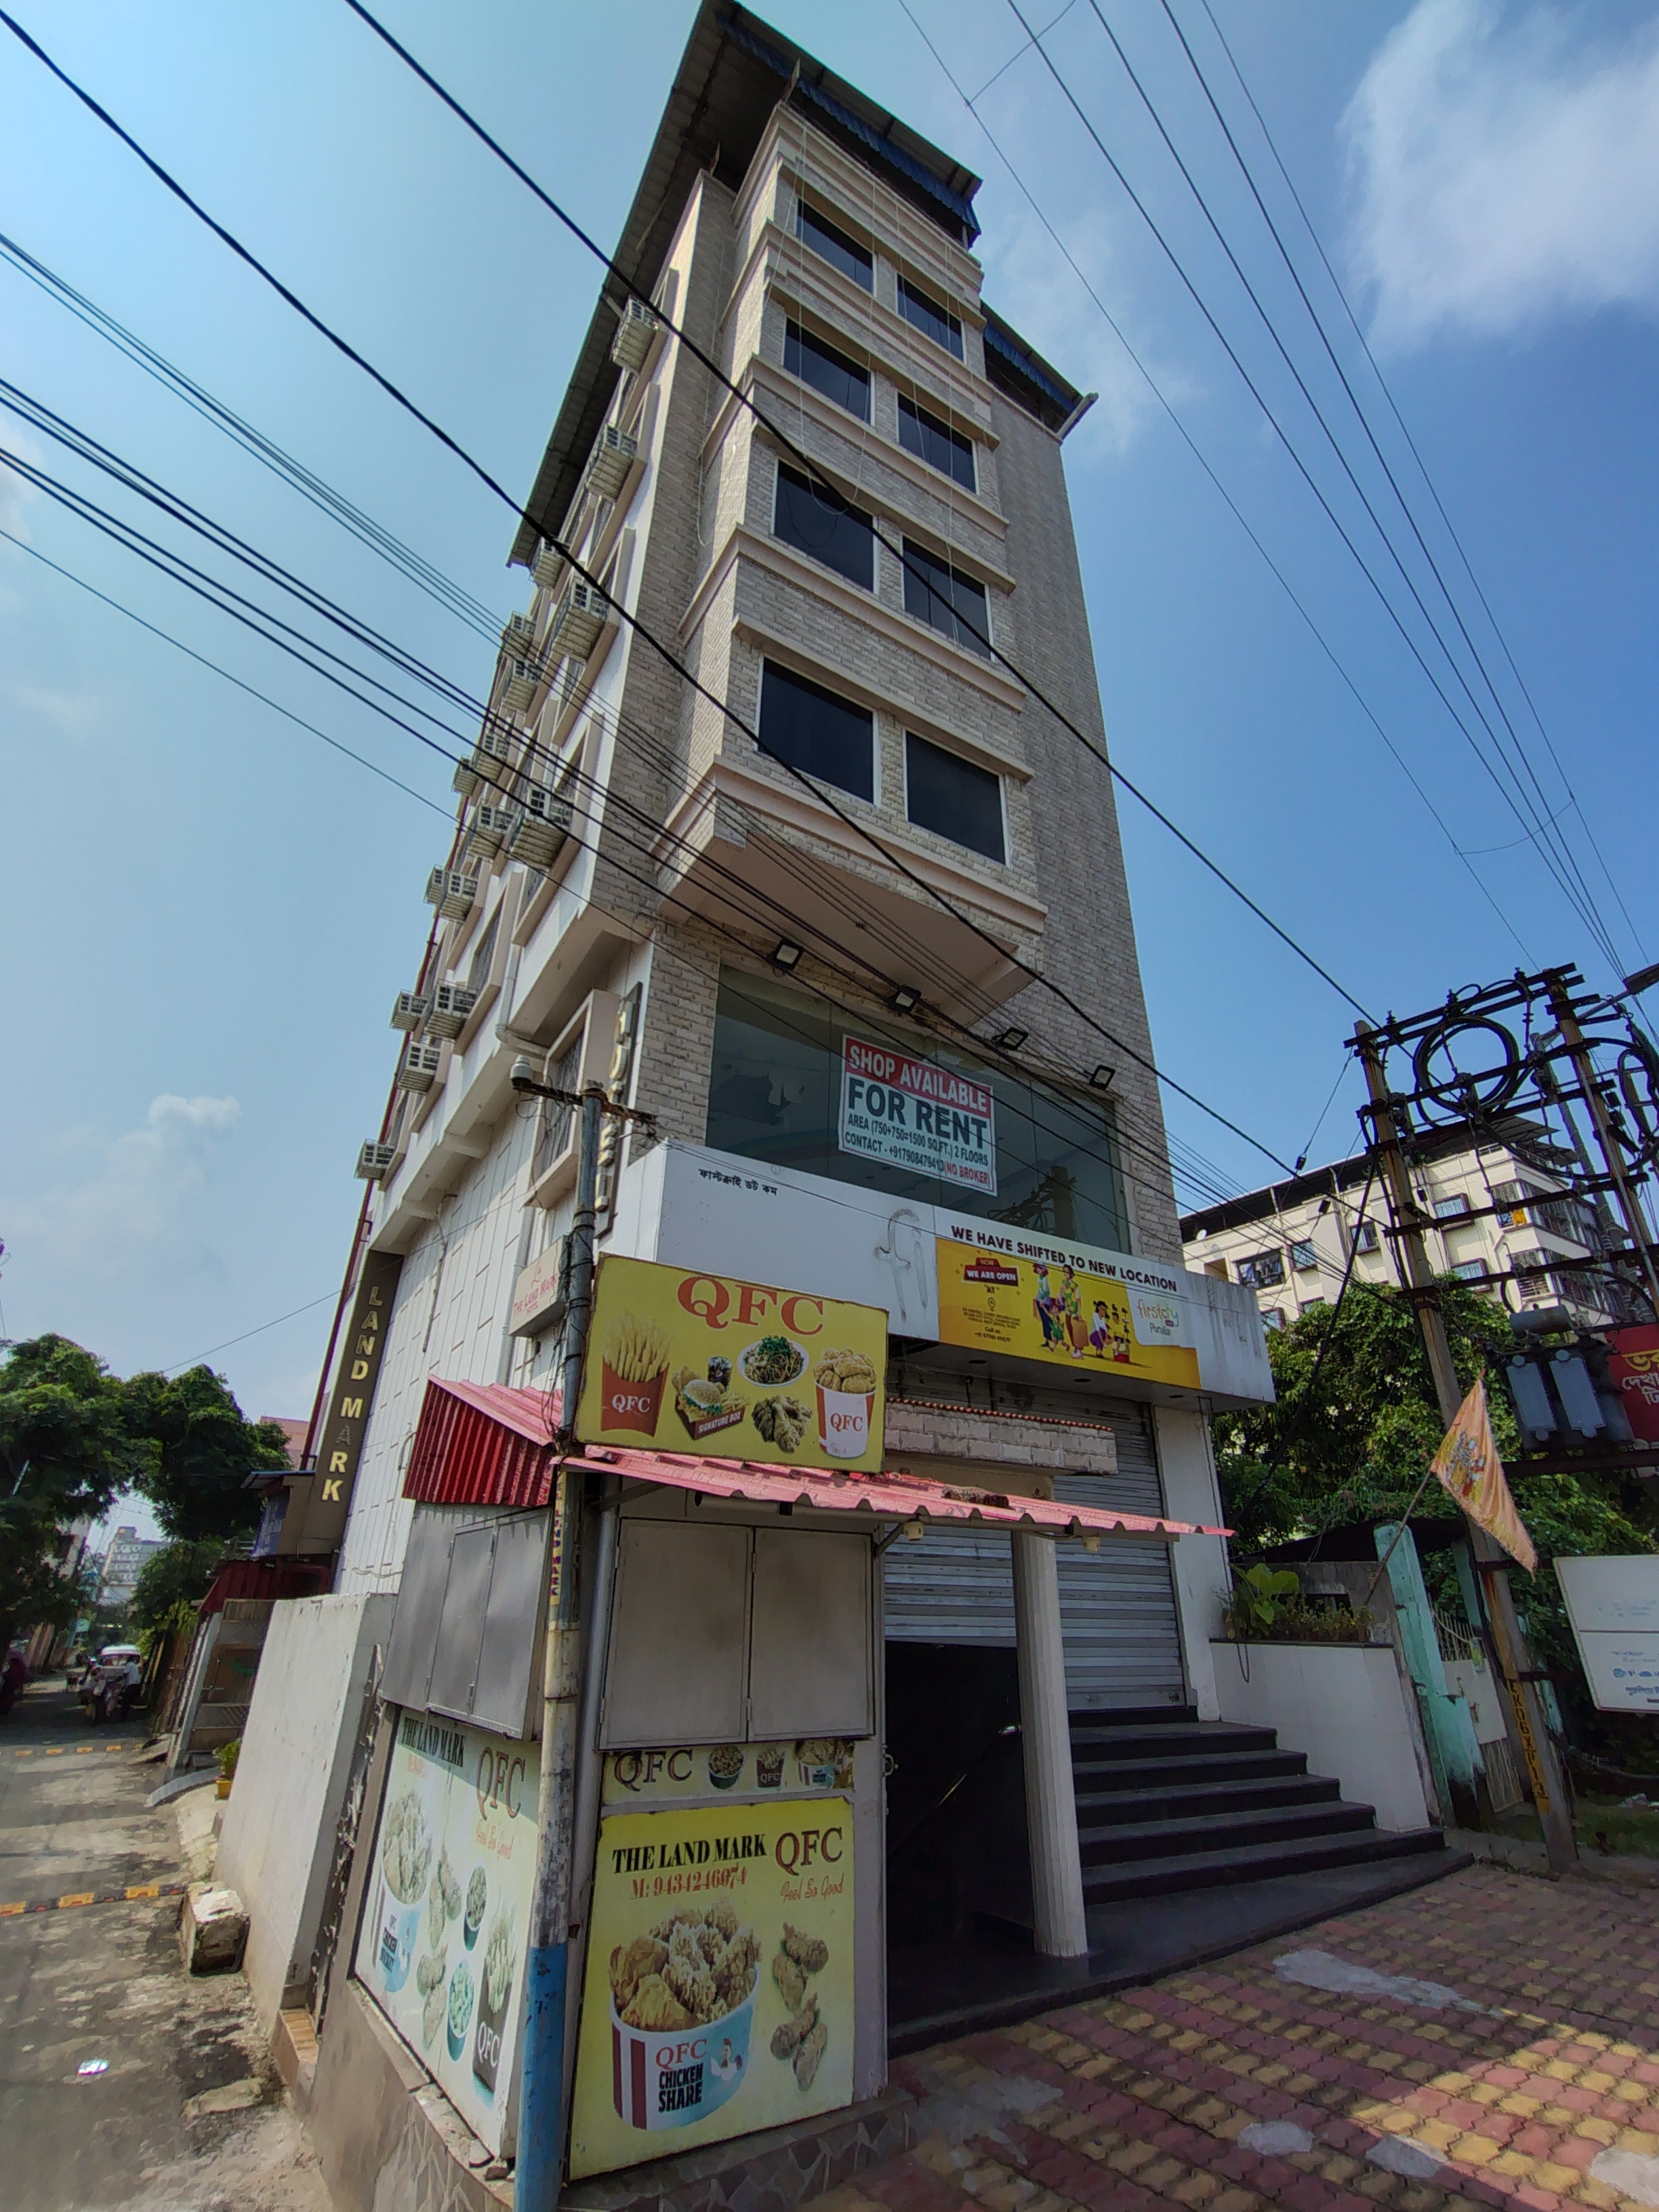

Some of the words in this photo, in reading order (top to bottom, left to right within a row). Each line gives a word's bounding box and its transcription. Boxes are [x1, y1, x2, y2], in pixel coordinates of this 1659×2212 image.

[849, 1045, 895, 1080] SHOP
[900, 1064, 987, 1113] AVAILABLE
[848, 1077, 907, 1126] FOR
[916, 1099, 987, 1149] RENT
[845, 1131, 883, 1153] CONTACT
[848, 1113, 869, 1130] AREA
[872, 1119, 926, 1149] (750+750=1500
[954, 1145, 959, 1158] 2
[961, 1147, 989, 1166] FLOORS
[761, 1184, 778, 1196] কম
[951, 1225, 973, 1242] WE
[977, 1231, 1013, 1251] HAVE
[1017, 1242, 1066, 1264] SHIFTED
[1069, 1254, 1085, 1269] TO
[1088, 1259, 1116, 1276] NEW
[1120, 1267, 1177, 1292] LOCATION
[966, 1270, 979, 1278] WE
[981, 1271, 995, 1279] ARE
[996, 1273, 1016, 1281] OPEN
[678, 1276, 824, 1336] QFC
[350, 1286, 384, 1380] LAND
[612, 1393, 651, 1414] QFC
[698, 1415, 729, 1433] SIGNATURE
[729, 1410, 742, 1423] BOX
[830, 1412, 864, 1432] QFC
[321, 1396, 364, 1502] MARK
[476, 1746, 526, 1822] QFC
[614, 1748, 693, 1793] QFC
[760, 1772, 780, 1784] QFC
[613, 1845, 655, 1874] THE
[658, 1840, 710, 1869] LAND
[714, 1833, 767, 1862] MARK
[775, 1826, 843, 1877] QFC
[478, 2021, 500, 2068] QFC
[655, 2038, 708, 2071] QFC
[658, 2081, 703, 2113] SHARE
[659, 2063, 704, 2090] CHICKEN
